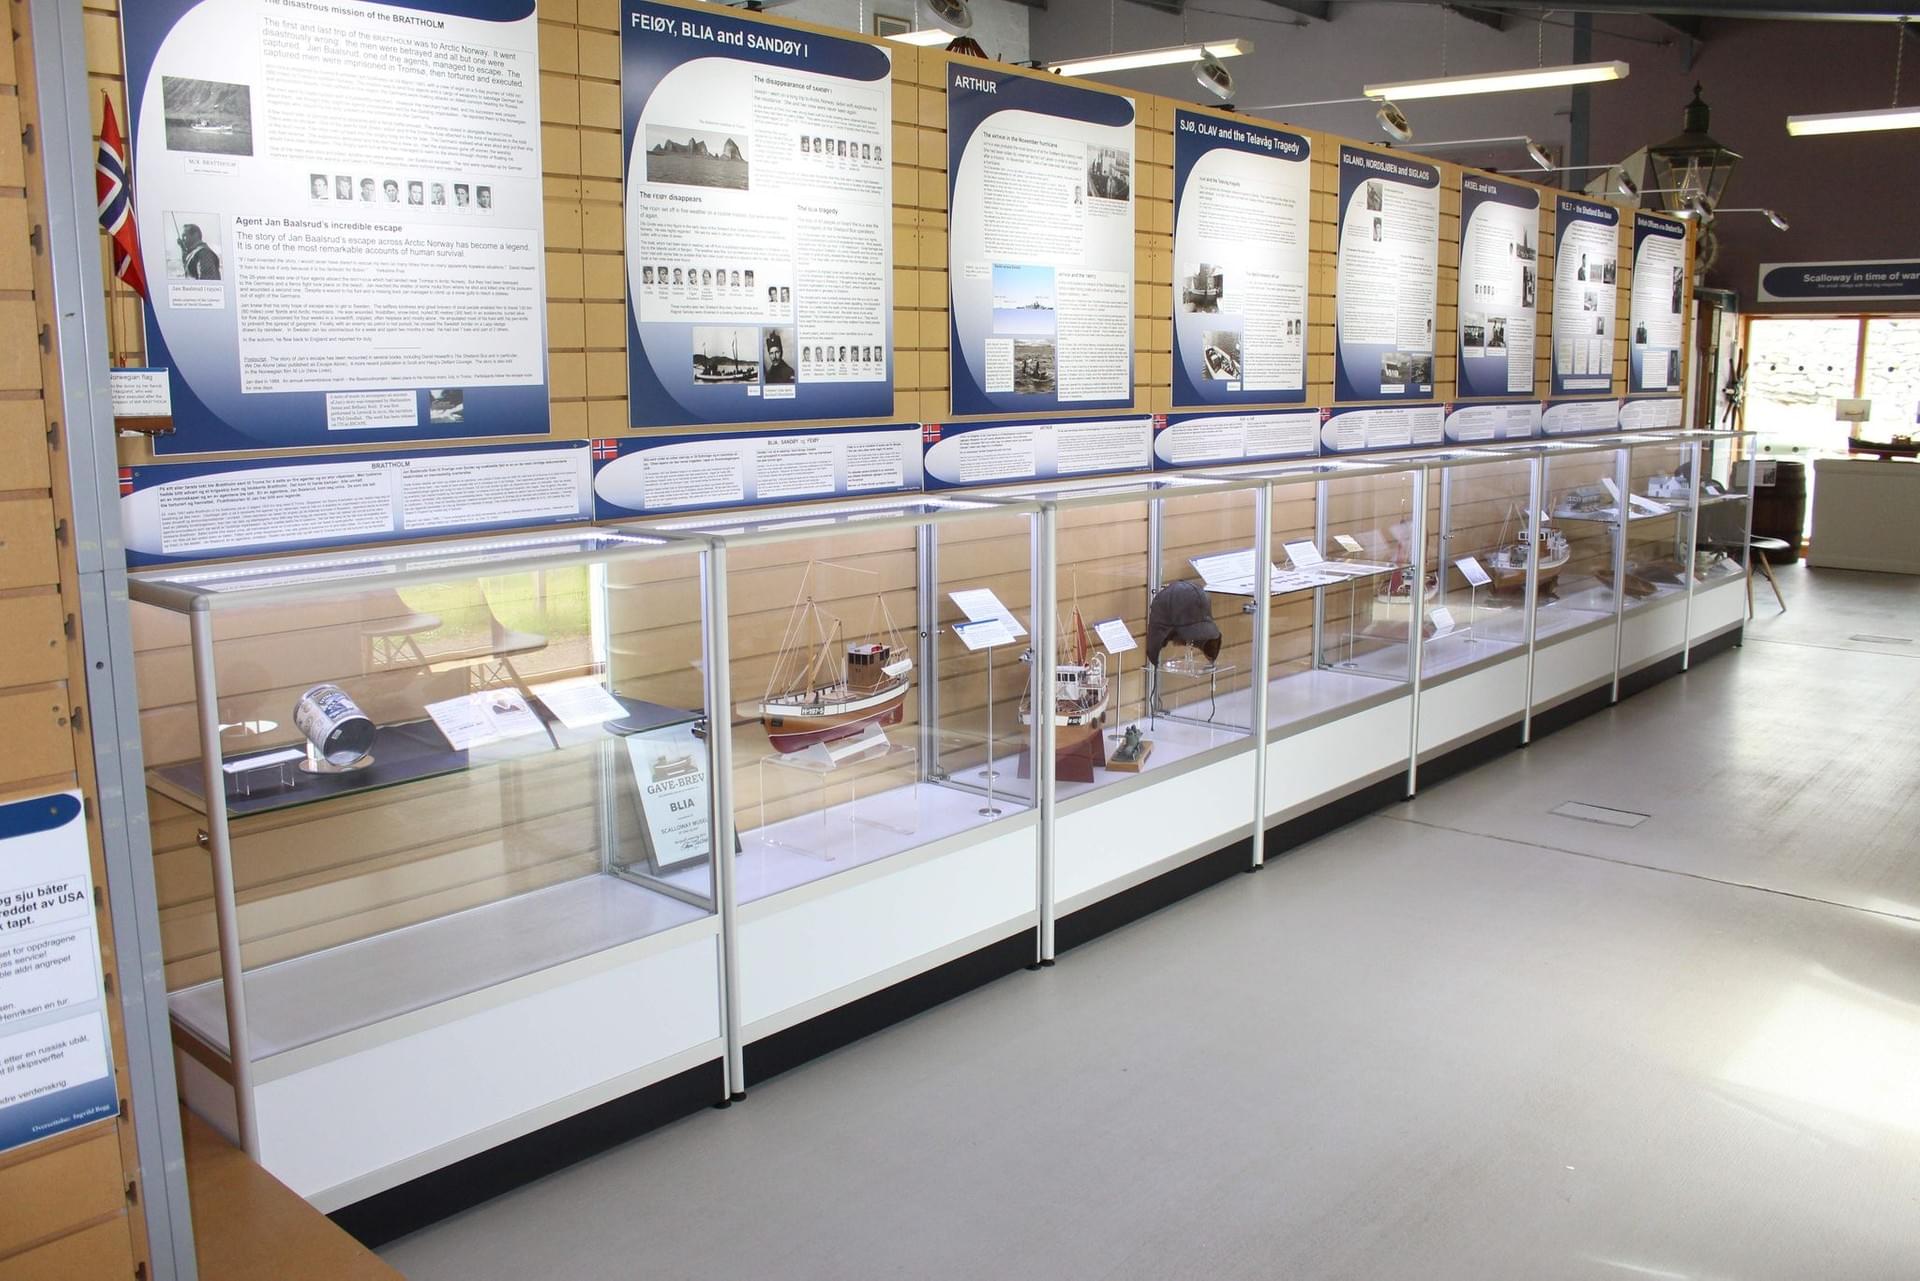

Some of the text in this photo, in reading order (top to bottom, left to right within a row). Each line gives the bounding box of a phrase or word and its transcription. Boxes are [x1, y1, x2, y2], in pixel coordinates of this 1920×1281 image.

[282, 0, 328, 12] disastrous
[331, 6, 365, 17] mission
[366, 11, 375, 19] of
[377, 12, 391, 21] the
[392, 14, 445, 29] BRATTHOLM
[264, 17, 280, 27] The
[414, 40, 429, 48] was
[430, 41, 438, 49] to
[439, 42, 460, 53] Arctic
[500, 52, 516, 60] went
[631, 13, 677, 37] FEIØY,
[681, 22, 714, 41] BLIA
[717, 30, 744, 46] and
[747, 34, 802, 56] SANDØY
[400, 46, 433, 60] betrayed
[434, 52, 448, 60] and
[460, 54, 471, 63] but
[472, 56, 488, 65] one
[488, 59, 505, 68] were
[430, 68, 446, 78] then
[447, 70, 475, 82] tortured
[476, 75, 490, 84] and
[432, 60, 466, 74] managed
[467, 64, 475, 72] to
[507, 69, 521, 79] The
[954, 75, 997, 94] ARTHUR
[1180, 120, 1300, 155] SJØ, OLAV and the Telavåg Tragedy
[1398, 166, 1408, 176] and
[640, 191, 651, 199] The
[668, 194, 702, 203] disappears
[235, 217, 263, 229] Agent
[265, 218, 281, 227] Jan
[331, 221, 372, 231] incredible
[374, 224, 402, 234] escape
[237, 231, 253, 240] The
[255, 232, 276, 243] story
[277, 233, 286, 242] of
[288, 234, 303, 243] Jan
[348, 237, 376, 247] escape
[404, 238, 425, 247] Arctic
[426, 240, 455, 250] Norway
[456, 241, 469, 249] has
[470, 241, 498, 250] become
[237, 242, 244, 250] It
[245, 242, 252, 250] is
[254, 243, 270, 251] one
[272, 242, 281, 251] of
[282, 242, 295, 252] the
[297, 244, 318, 253] most
[319, 244, 363, 255] remarkable
[365, 246, 399, 256] accounts
[400, 247, 408, 255] of
[409, 248, 435, 257] human
[1803, 274, 1852, 283] Scalloway
[1865, 272, 1887, 281] time
[1889, 271, 1901, 280] of
[371, 461, 410, 469] BRATTHOLM
[647, 772, 705, 795] GAVE-BREV
[670, 798, 695, 812] BLIA
[661, 822, 691, 835] SCALLOWAY
[15, 890, 34, 903] sju
[37, 883, 69, 897] båter
[41, 898, 55, 909] av
[58, 890, 85, 905] USA
[7, 916, 35, 928] tapt.
[26, 935, 76, 952] oppdragene
[14, 964, 33, 975] aldri
[34, 954, 71, 969] angrepet
[44, 1001, 55, 1009] en
[25, 1050, 37, 1058] en
[38, 1041, 67, 1054] russisk
[16, 1051, 64, 1072] skipsverftet
